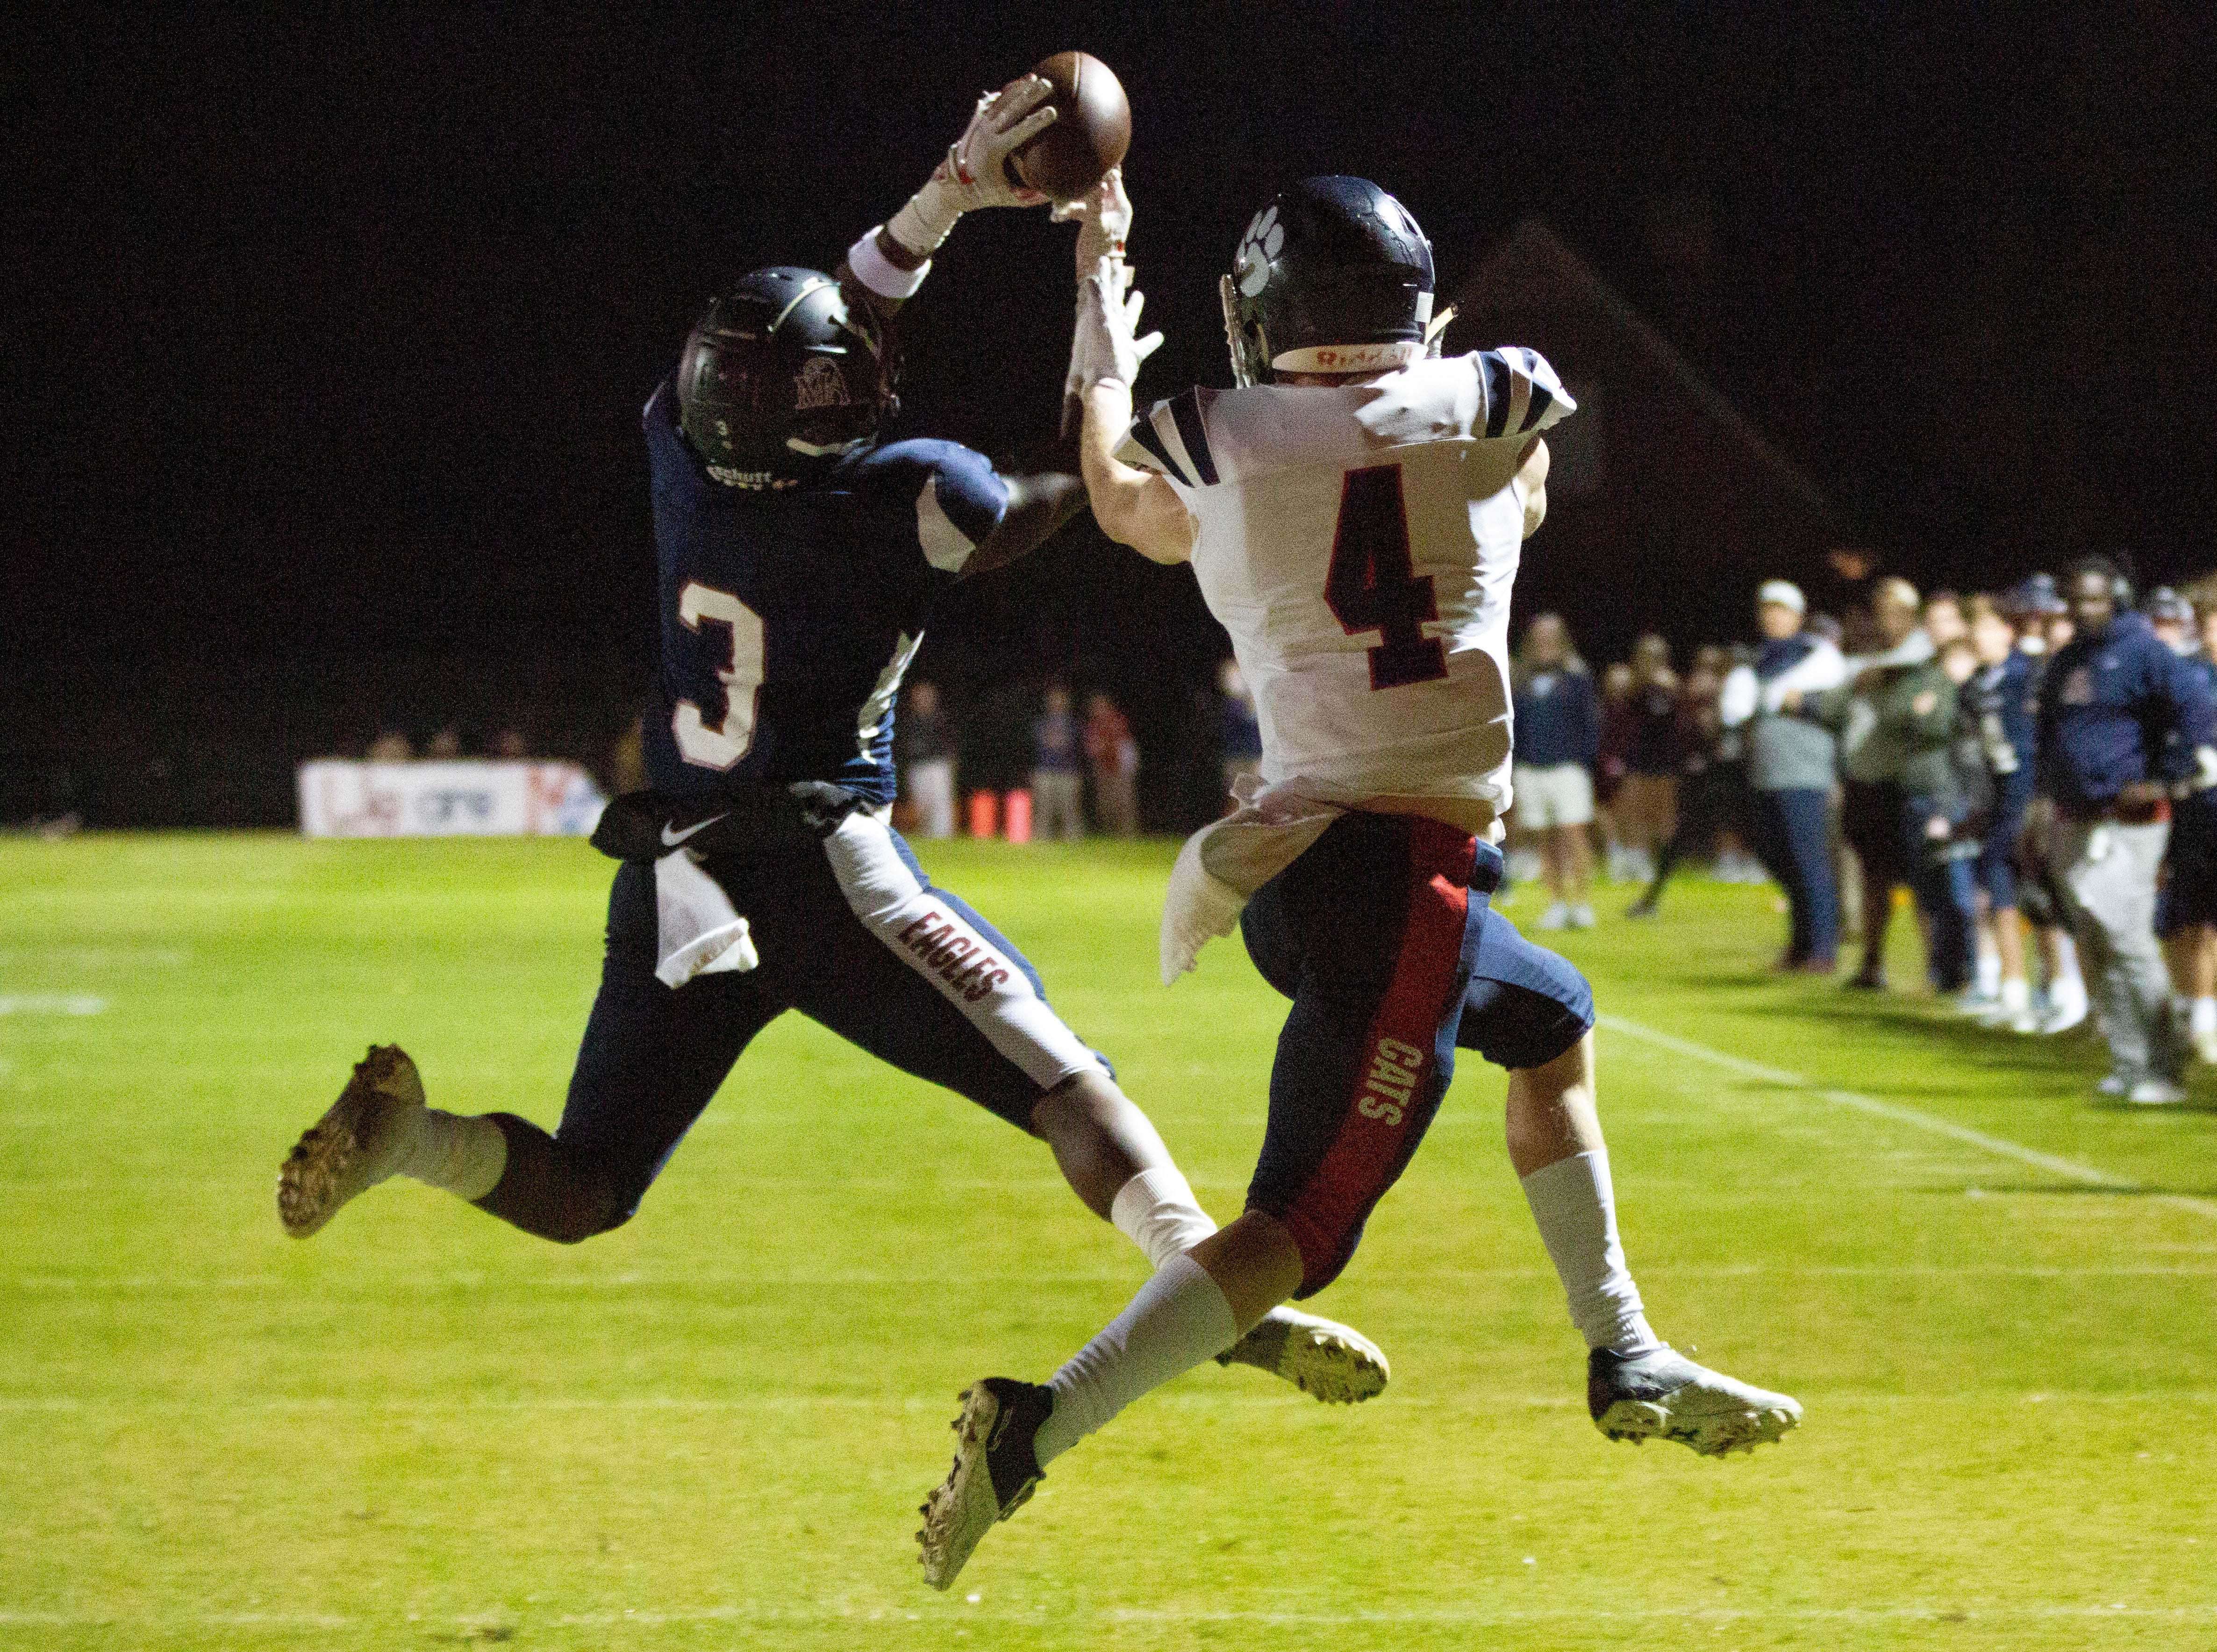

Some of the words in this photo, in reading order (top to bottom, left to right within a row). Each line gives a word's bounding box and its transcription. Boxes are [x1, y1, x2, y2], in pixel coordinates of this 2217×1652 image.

[1323, 463, 1449, 691] 4
[672, 582, 764, 772] 3
[898, 911, 1009, 1002] EAGLES
[1358, 1037, 1423, 1125] CATS
